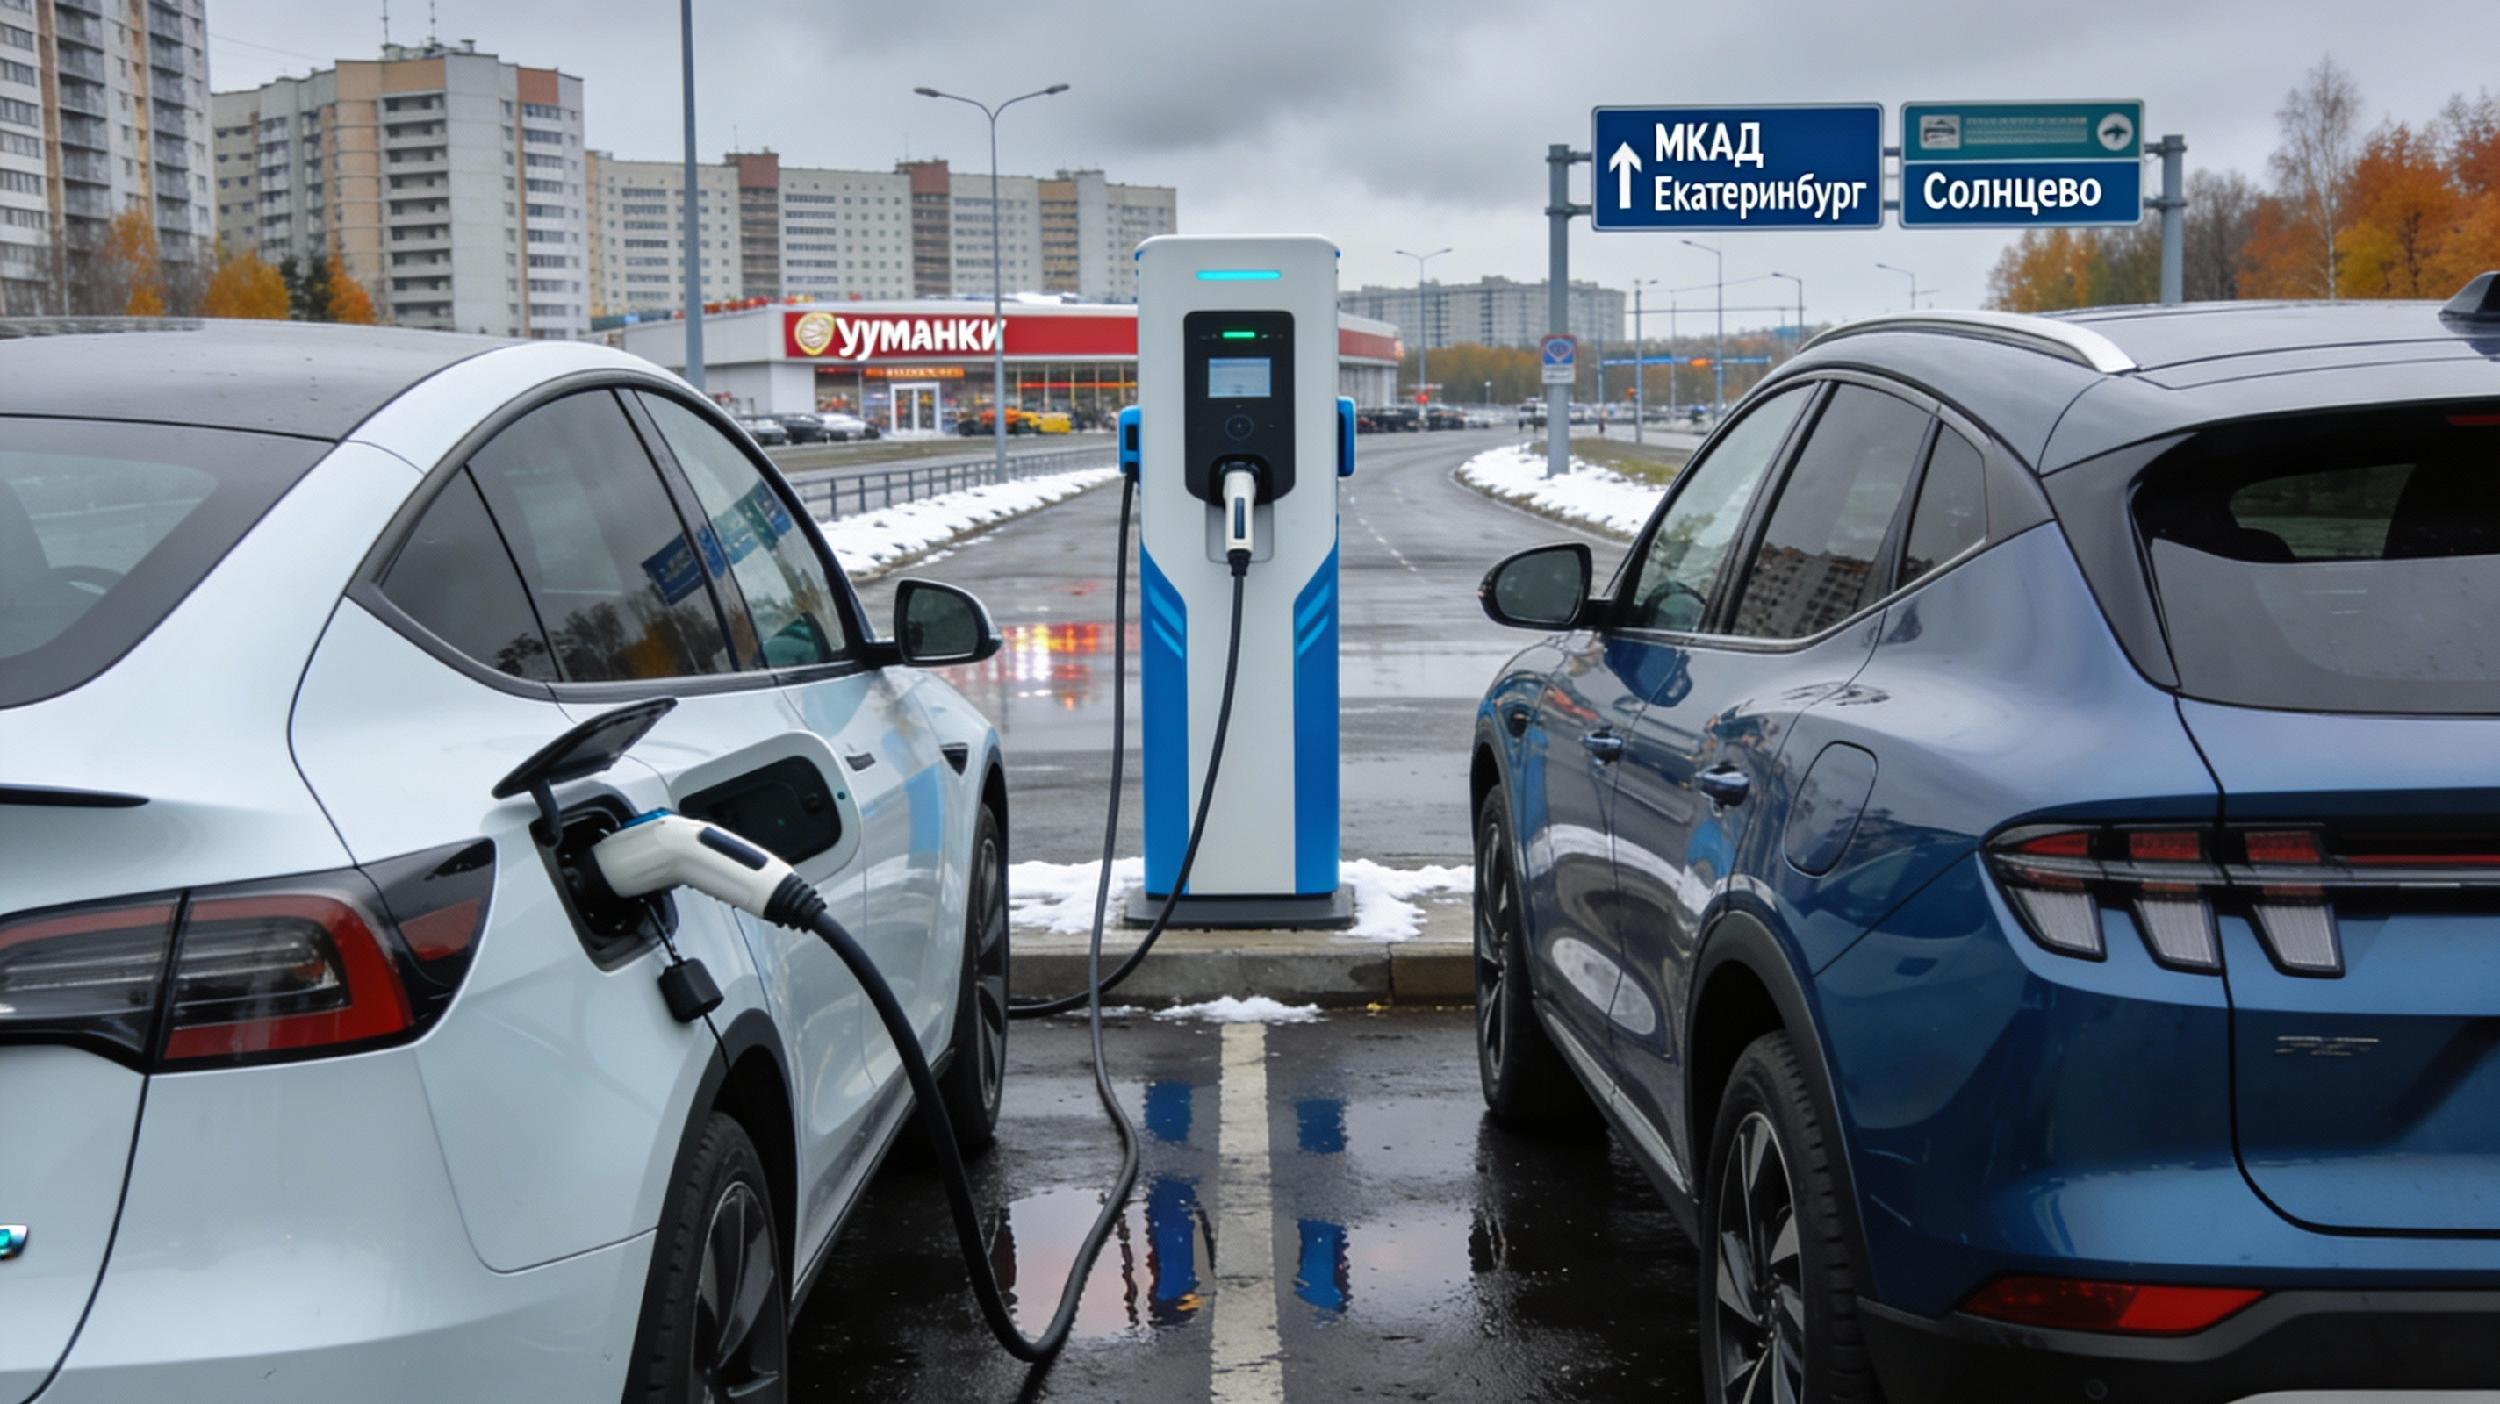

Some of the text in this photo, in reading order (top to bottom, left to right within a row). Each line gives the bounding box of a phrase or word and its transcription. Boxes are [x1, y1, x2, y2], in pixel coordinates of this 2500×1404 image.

[1655, 122, 1764, 168] МКАД
[1655, 173, 1867, 220] Екатеринбург
[1923, 171, 2102, 216] Солнцево
